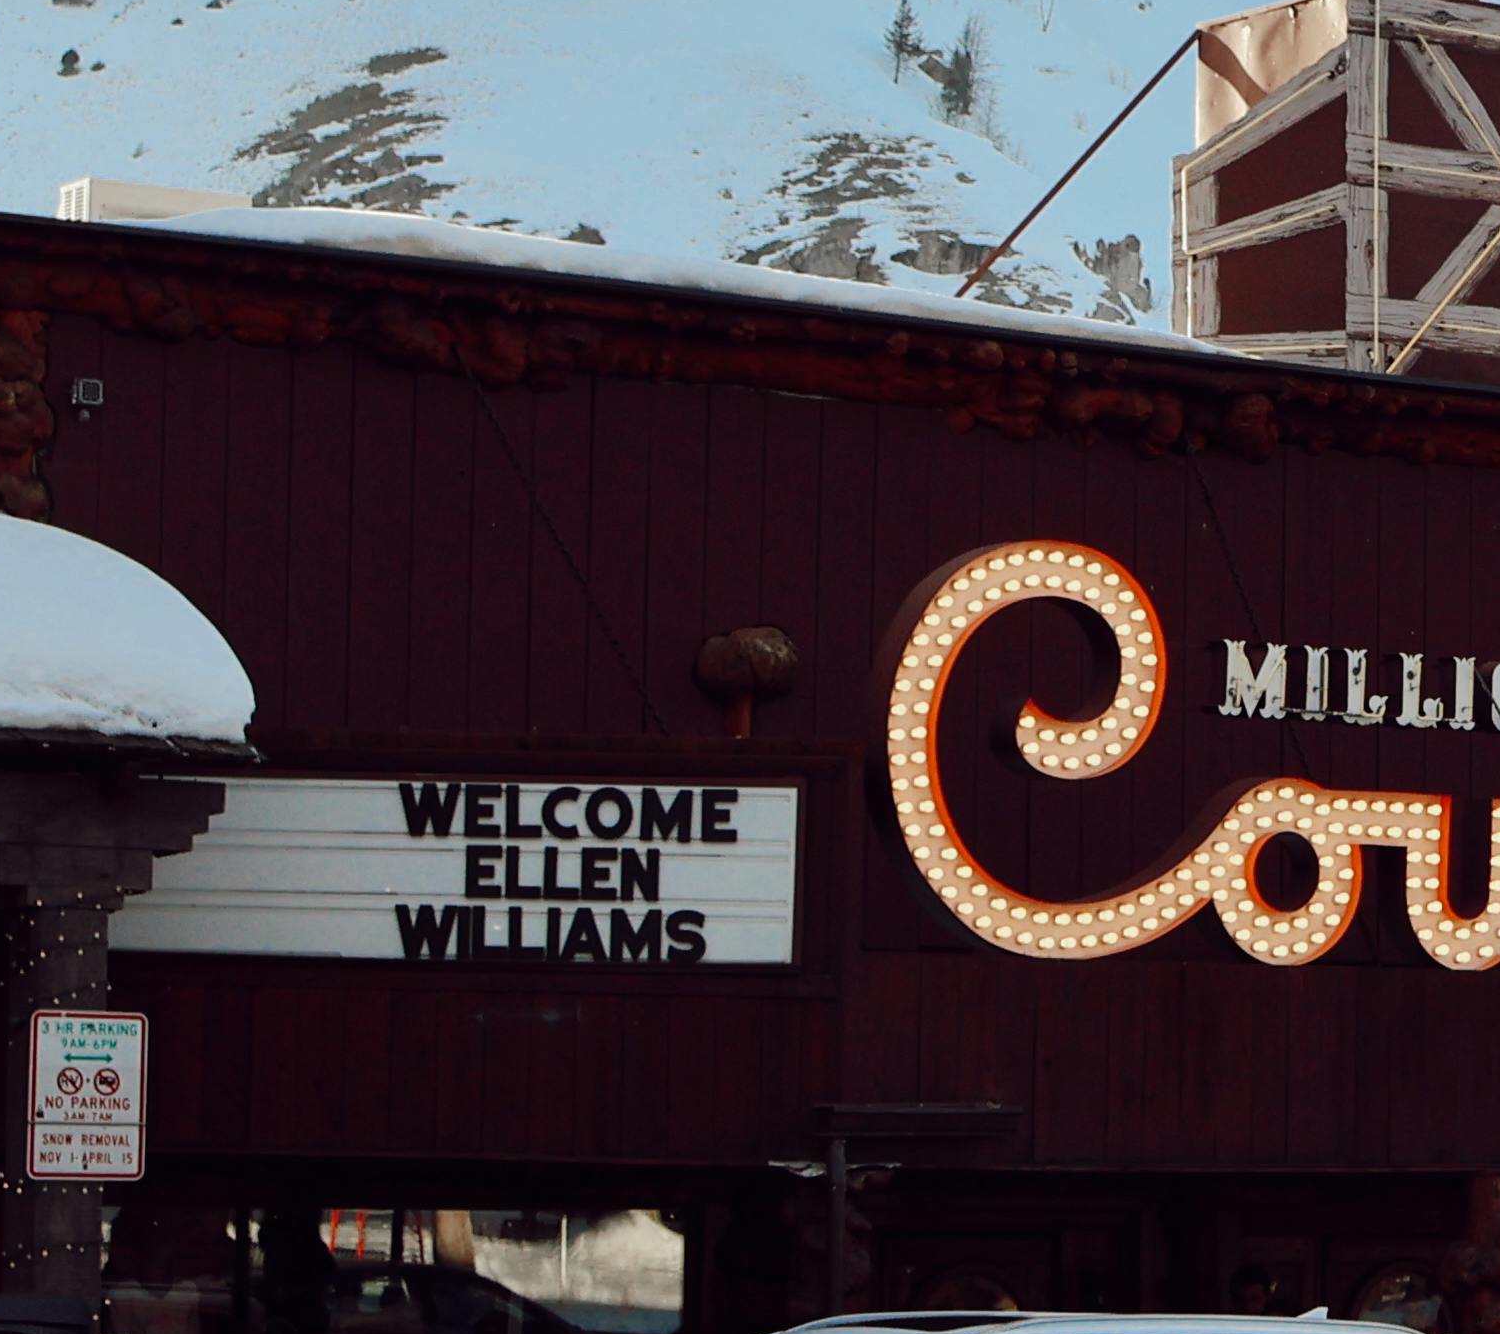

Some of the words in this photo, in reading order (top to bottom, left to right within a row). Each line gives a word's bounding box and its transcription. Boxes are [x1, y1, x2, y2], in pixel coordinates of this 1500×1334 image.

[399, 783, 739, 843] WELCOME
[465, 845, 660, 902] ELLEN
[394, 904, 707, 962] WILLIAMS
[41, 1021, 49, 1035] 3
[56, 1022, 74, 1035] HR
[81, 1023, 138, 1036] PARKING
[44, 1096, 64, 1109] NO
[71, 1096, 131, 1110] PARKING
[42, 1134, 72, 1145] SNOW
[81, 1135, 131, 1146] REMOVAL
[40, 1152, 62, 1163] NOV
[122, 1153, 133, 1164] 15
